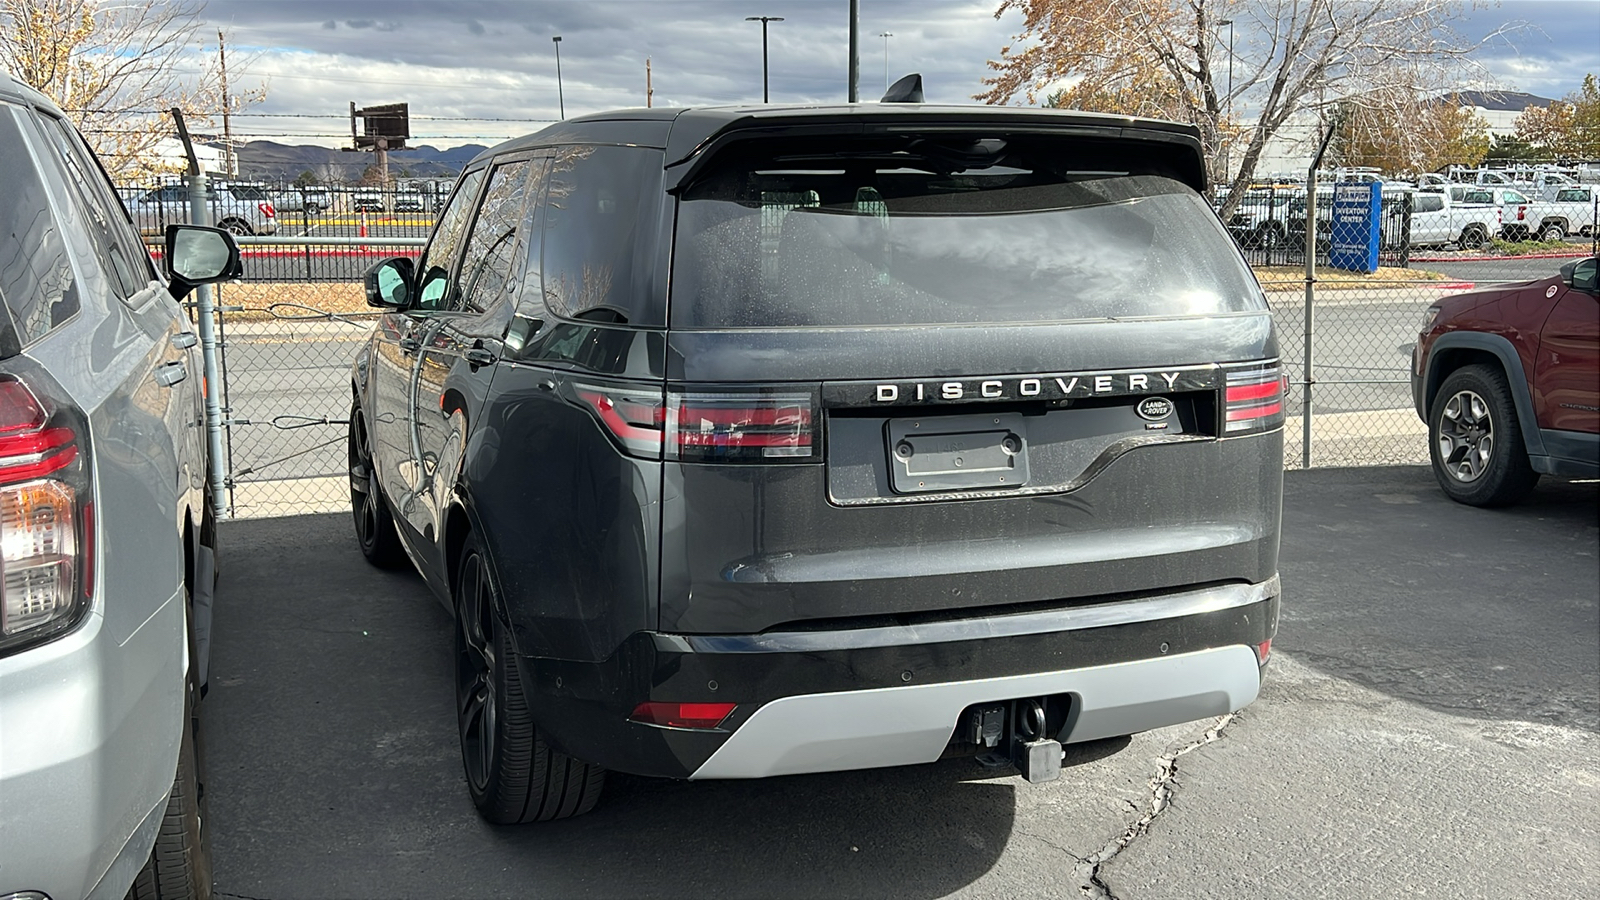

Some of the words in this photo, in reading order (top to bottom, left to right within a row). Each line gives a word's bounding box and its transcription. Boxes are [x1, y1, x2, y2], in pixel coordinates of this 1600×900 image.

[1337, 192, 1369, 200] CHAMPION
[1340, 215, 1363, 223] CENTER
[876, 372, 1180, 401] DISCOVERY
[1145, 401, 1163, 409] LAND
[1147, 407, 1168, 415] ROVER
